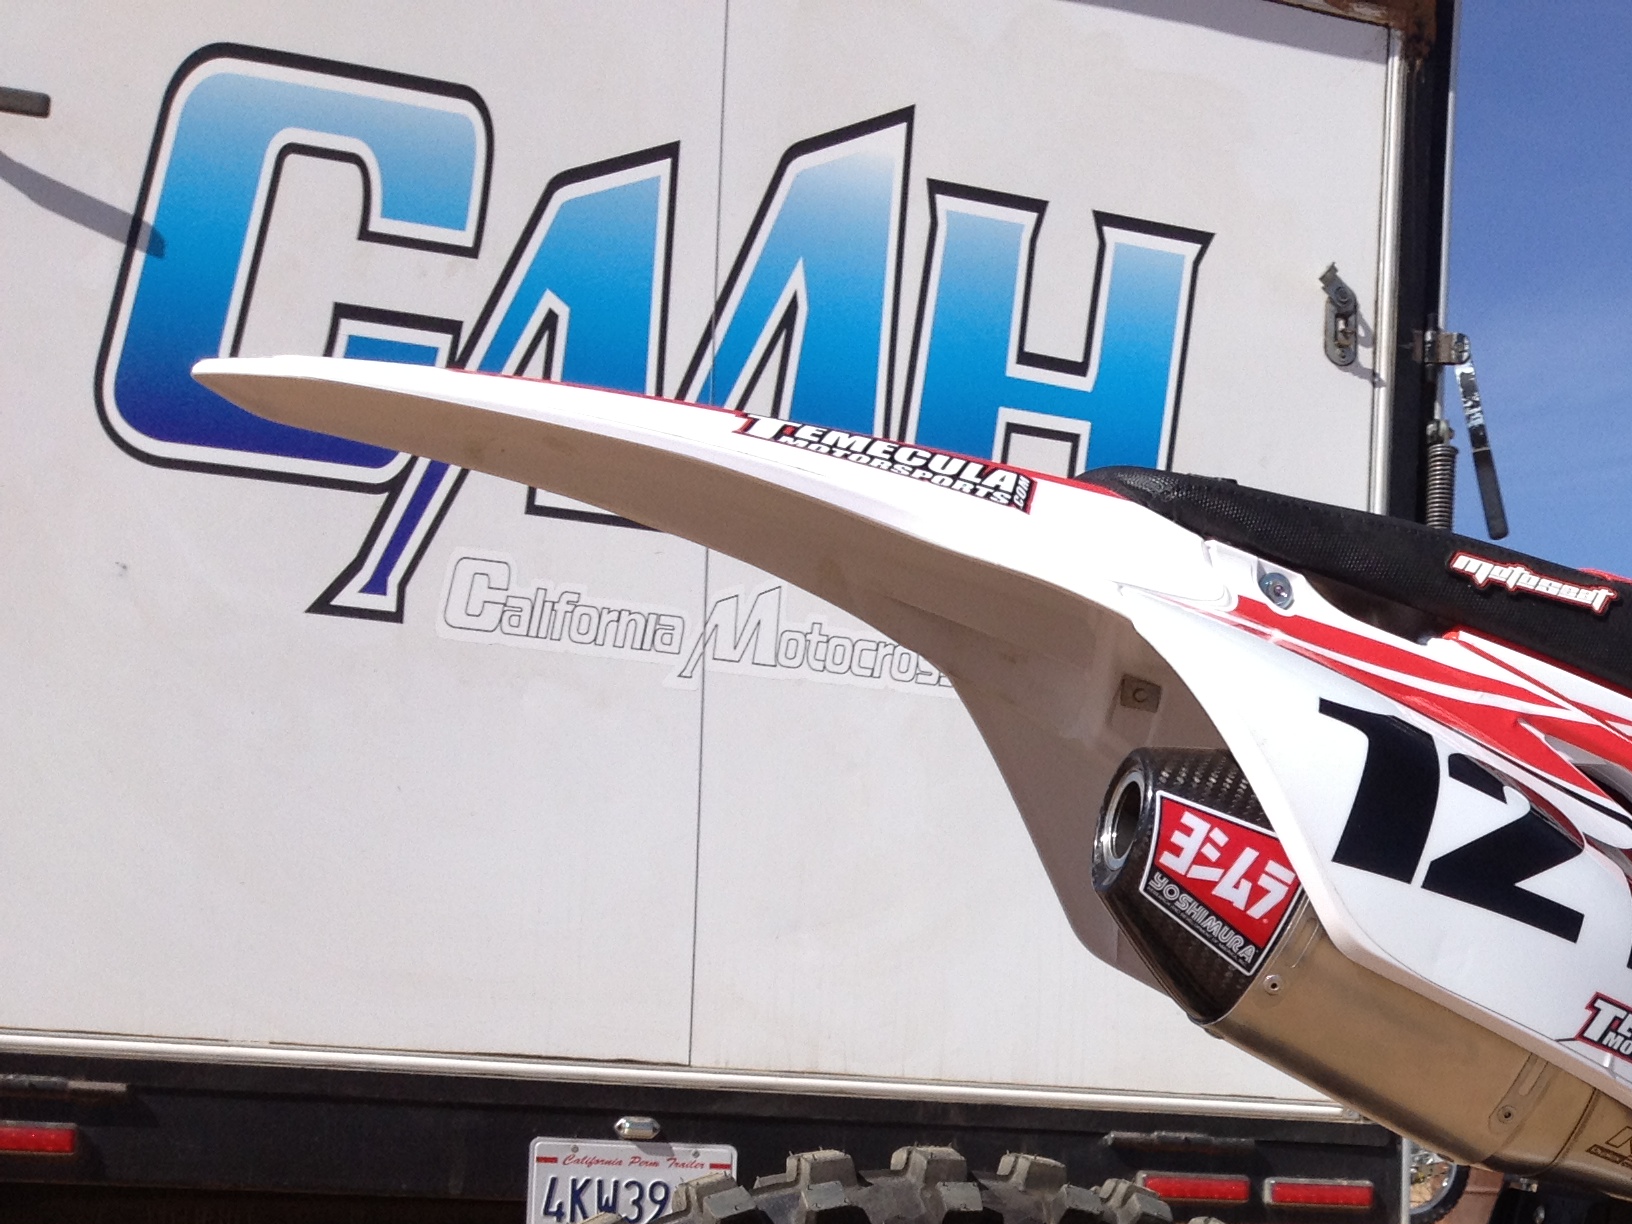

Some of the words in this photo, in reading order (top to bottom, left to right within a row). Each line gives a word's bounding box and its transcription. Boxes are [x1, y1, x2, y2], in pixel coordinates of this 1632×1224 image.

[95, 42, 1215, 616] CMH
[746, 413, 1018, 494] TEMECULA
[777, 435, 1012, 506] MOTORSPORTS
[443, 557, 604, 655] California
[678, 586, 956, 688] Motocros
[1158, 811, 1296, 920] ヨシムラ
[1148, 871, 1257, 964] YOSHIMURA
[562, 1153, 624, 1167] California
[628, 1156, 660, 1168] Perm
[666, 1157, 705, 1170] Trailer
